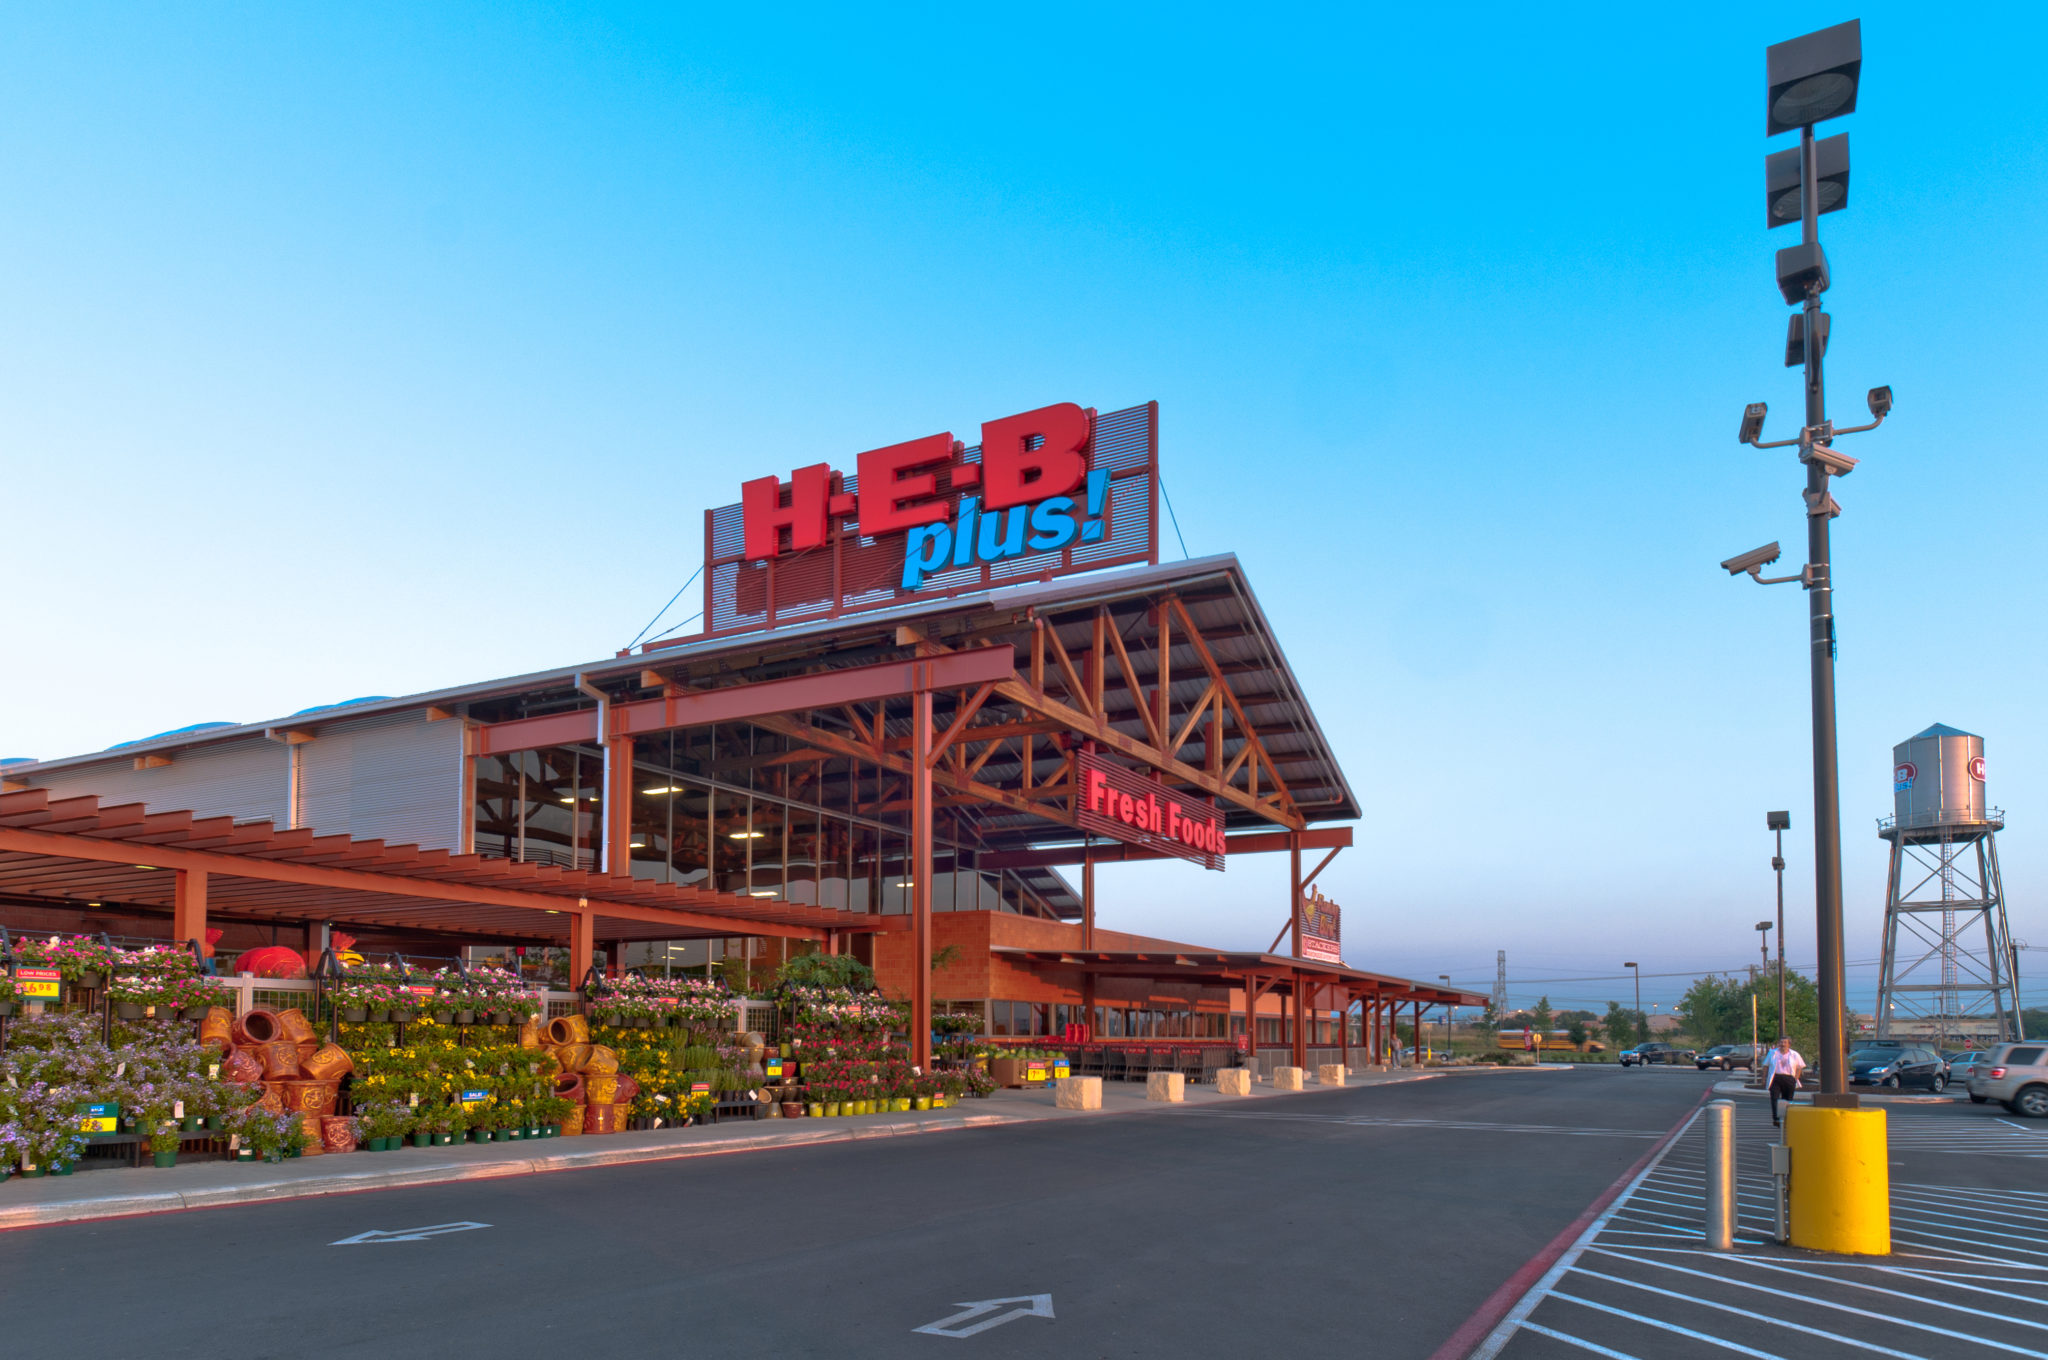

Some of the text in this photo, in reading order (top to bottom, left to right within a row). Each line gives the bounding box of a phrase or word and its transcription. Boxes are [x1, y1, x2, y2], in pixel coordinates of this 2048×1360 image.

[901, 467, 1112, 591] plus!
[1086, 769, 1226, 856] Fresh Foods
